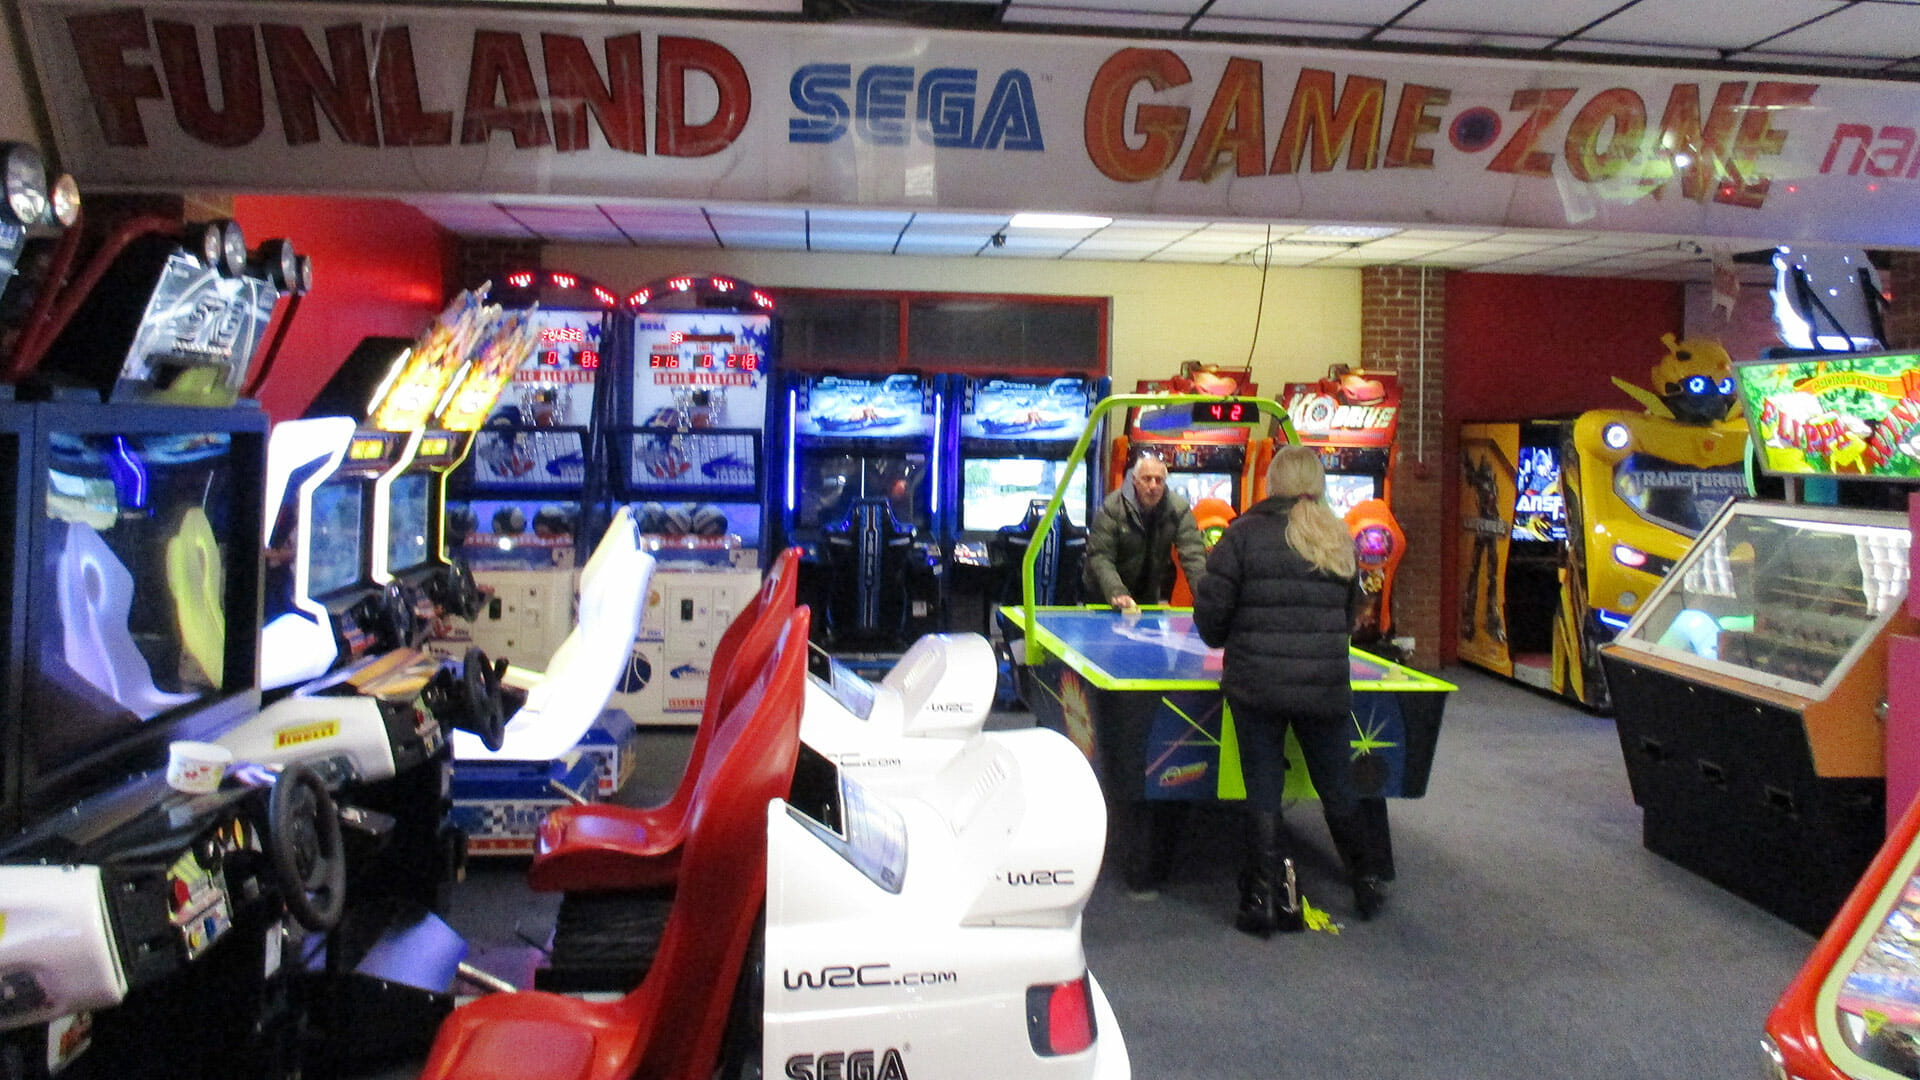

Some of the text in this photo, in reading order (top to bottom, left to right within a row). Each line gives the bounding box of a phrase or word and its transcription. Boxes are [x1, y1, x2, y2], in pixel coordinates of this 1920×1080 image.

[69, 8, 752, 158] FUNLAND
[788, 62, 1045, 152] SEGA
[1083, 46, 1820, 209] GAME ZONE
[1819, 122, 1920, 179] na
[1007, 869, 1075, 886] WRC
[784, 1047, 909, 1080] SEGA
